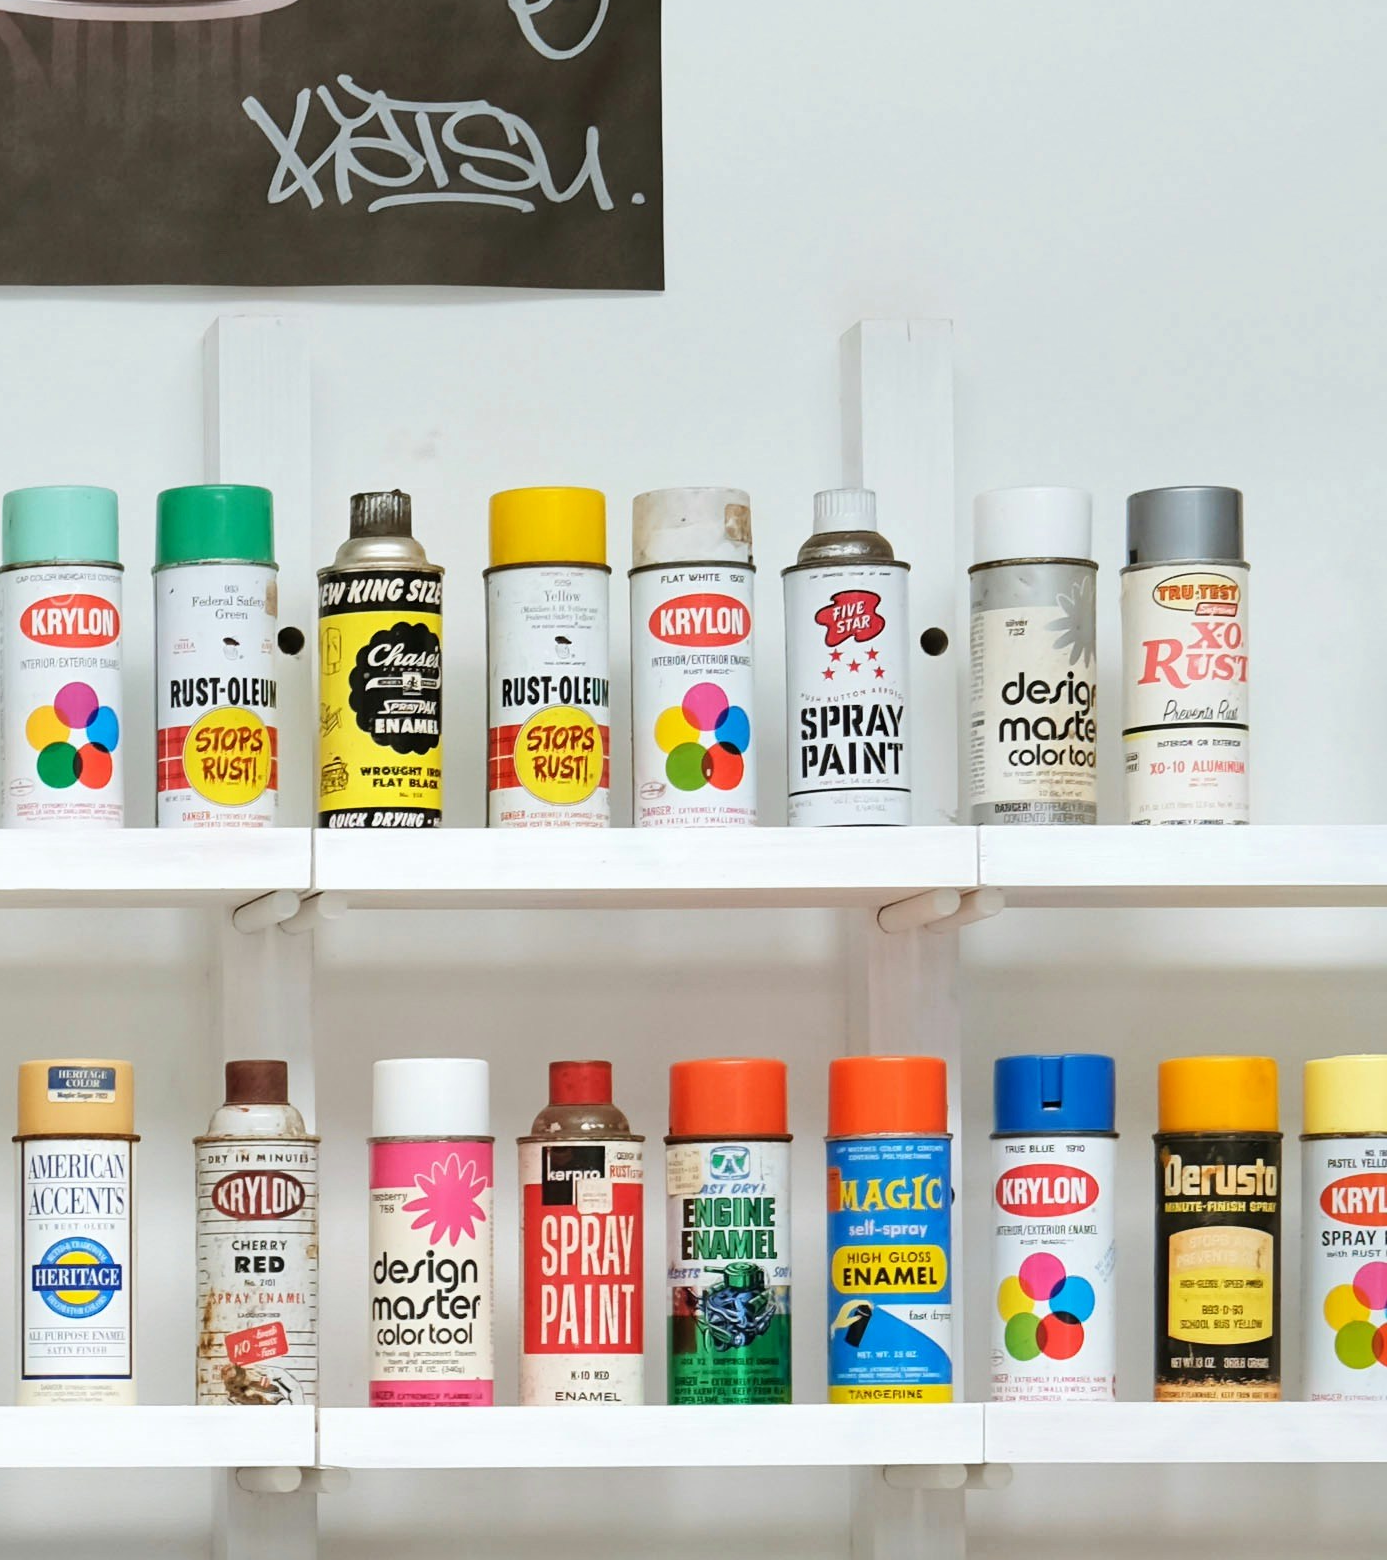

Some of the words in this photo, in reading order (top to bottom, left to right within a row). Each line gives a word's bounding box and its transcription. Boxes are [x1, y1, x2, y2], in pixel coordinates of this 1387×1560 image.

[344, 581, 405, 603] KING
[544, 591, 579, 603] Yellow
[832, 602, 866, 619] FIVE
[31, 608, 114, 637] KRYLON
[836, 615, 871, 632] STAR
[800, 705, 903, 740] SPRAY
[360, 766, 420, 777] WROUGHT
[532, 755, 588, 783] RUST!
[802, 743, 903, 779] PAINT
[1191, 762, 1244, 775] ALUMINUM
[1029, 1144, 1055, 1154] BLUE
[29, 1154, 124, 1181] AMERICAN
[838, 1175, 943, 1211] MAGIC
[683, 1198, 775, 1230] ENGINE
[231, 1240, 287, 1252] CHERRY
[542, 1216, 634, 1276] SPRAY
[234, 1255, 285, 1274] RED
[847, 1252, 885, 1264] HIGH
[891, 1252, 931, 1264] GLOSS
[842, 1266, 938, 1287] ENAMEL
[540, 1284, 635, 1346] PAINT
[848, 1388, 923, 1400] TANGERINE
